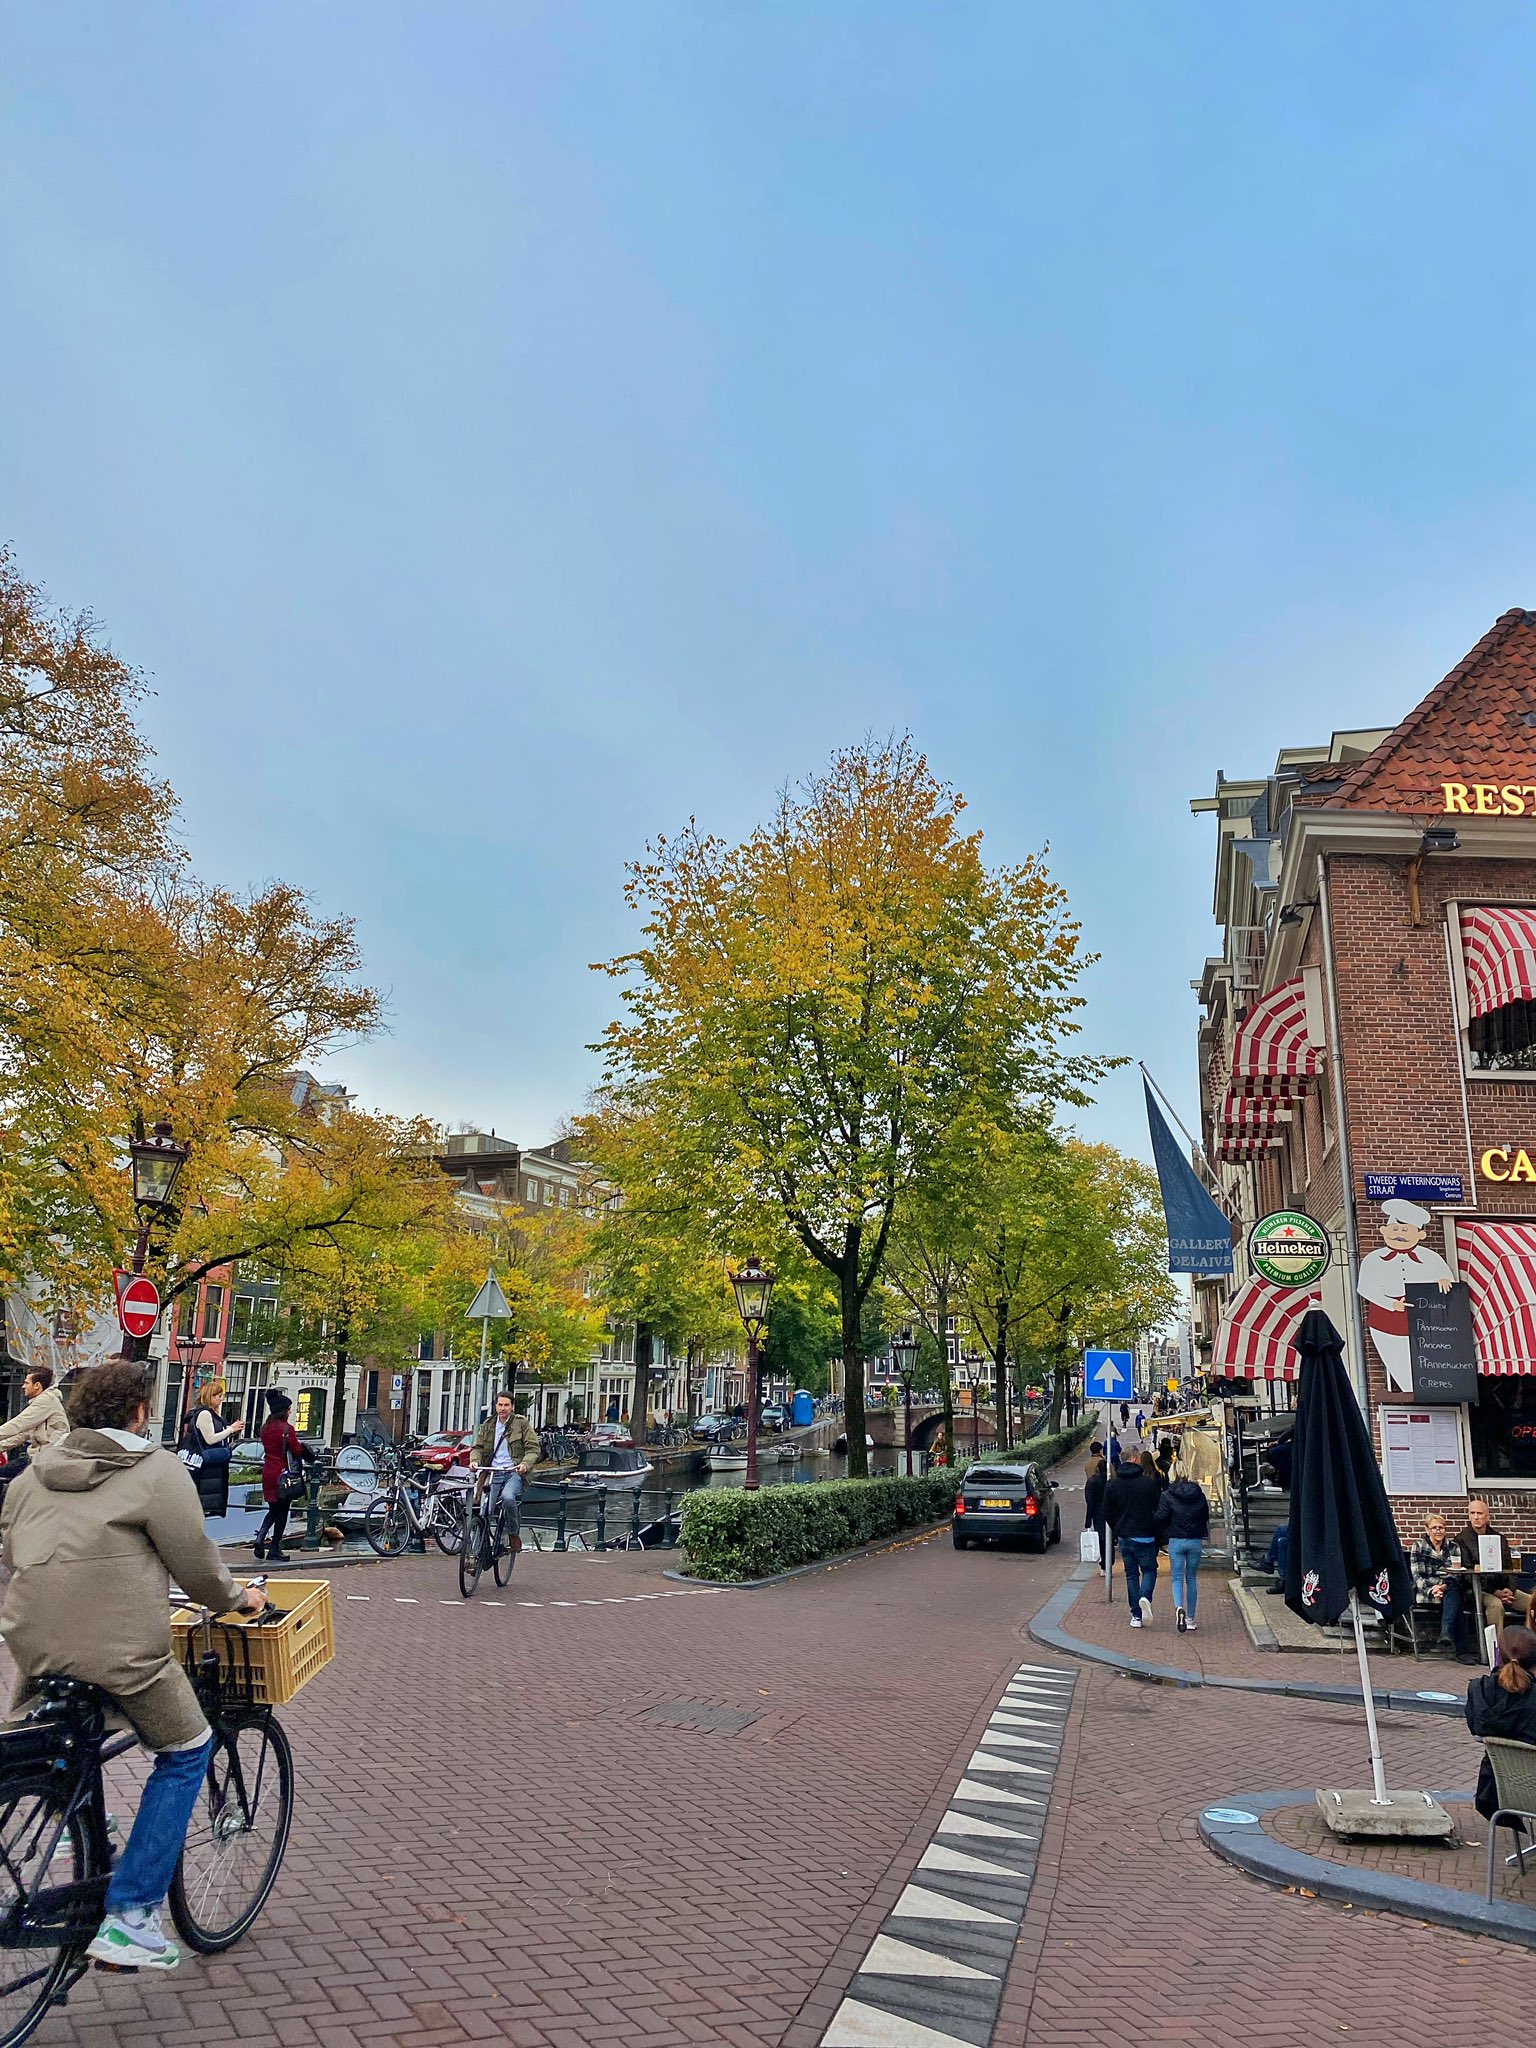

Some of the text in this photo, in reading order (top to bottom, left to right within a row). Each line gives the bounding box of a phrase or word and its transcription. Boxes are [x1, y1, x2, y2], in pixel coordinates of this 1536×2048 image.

[1368, 1176, 1461, 1186] TWEEDE WETERINGDWARS
[1368, 1186, 1395, 1194] STRAAT
[1261, 1217, 1315, 1234] HEINEKEN PILSENER
[1170, 1238, 1230, 1250] GALLERY
[1257, 1242, 1322, 1255] Heineken
[1170, 1255, 1232, 1267] DELAIVE
[1262, 1262, 1318, 1281] PREMIUM QUALITY
